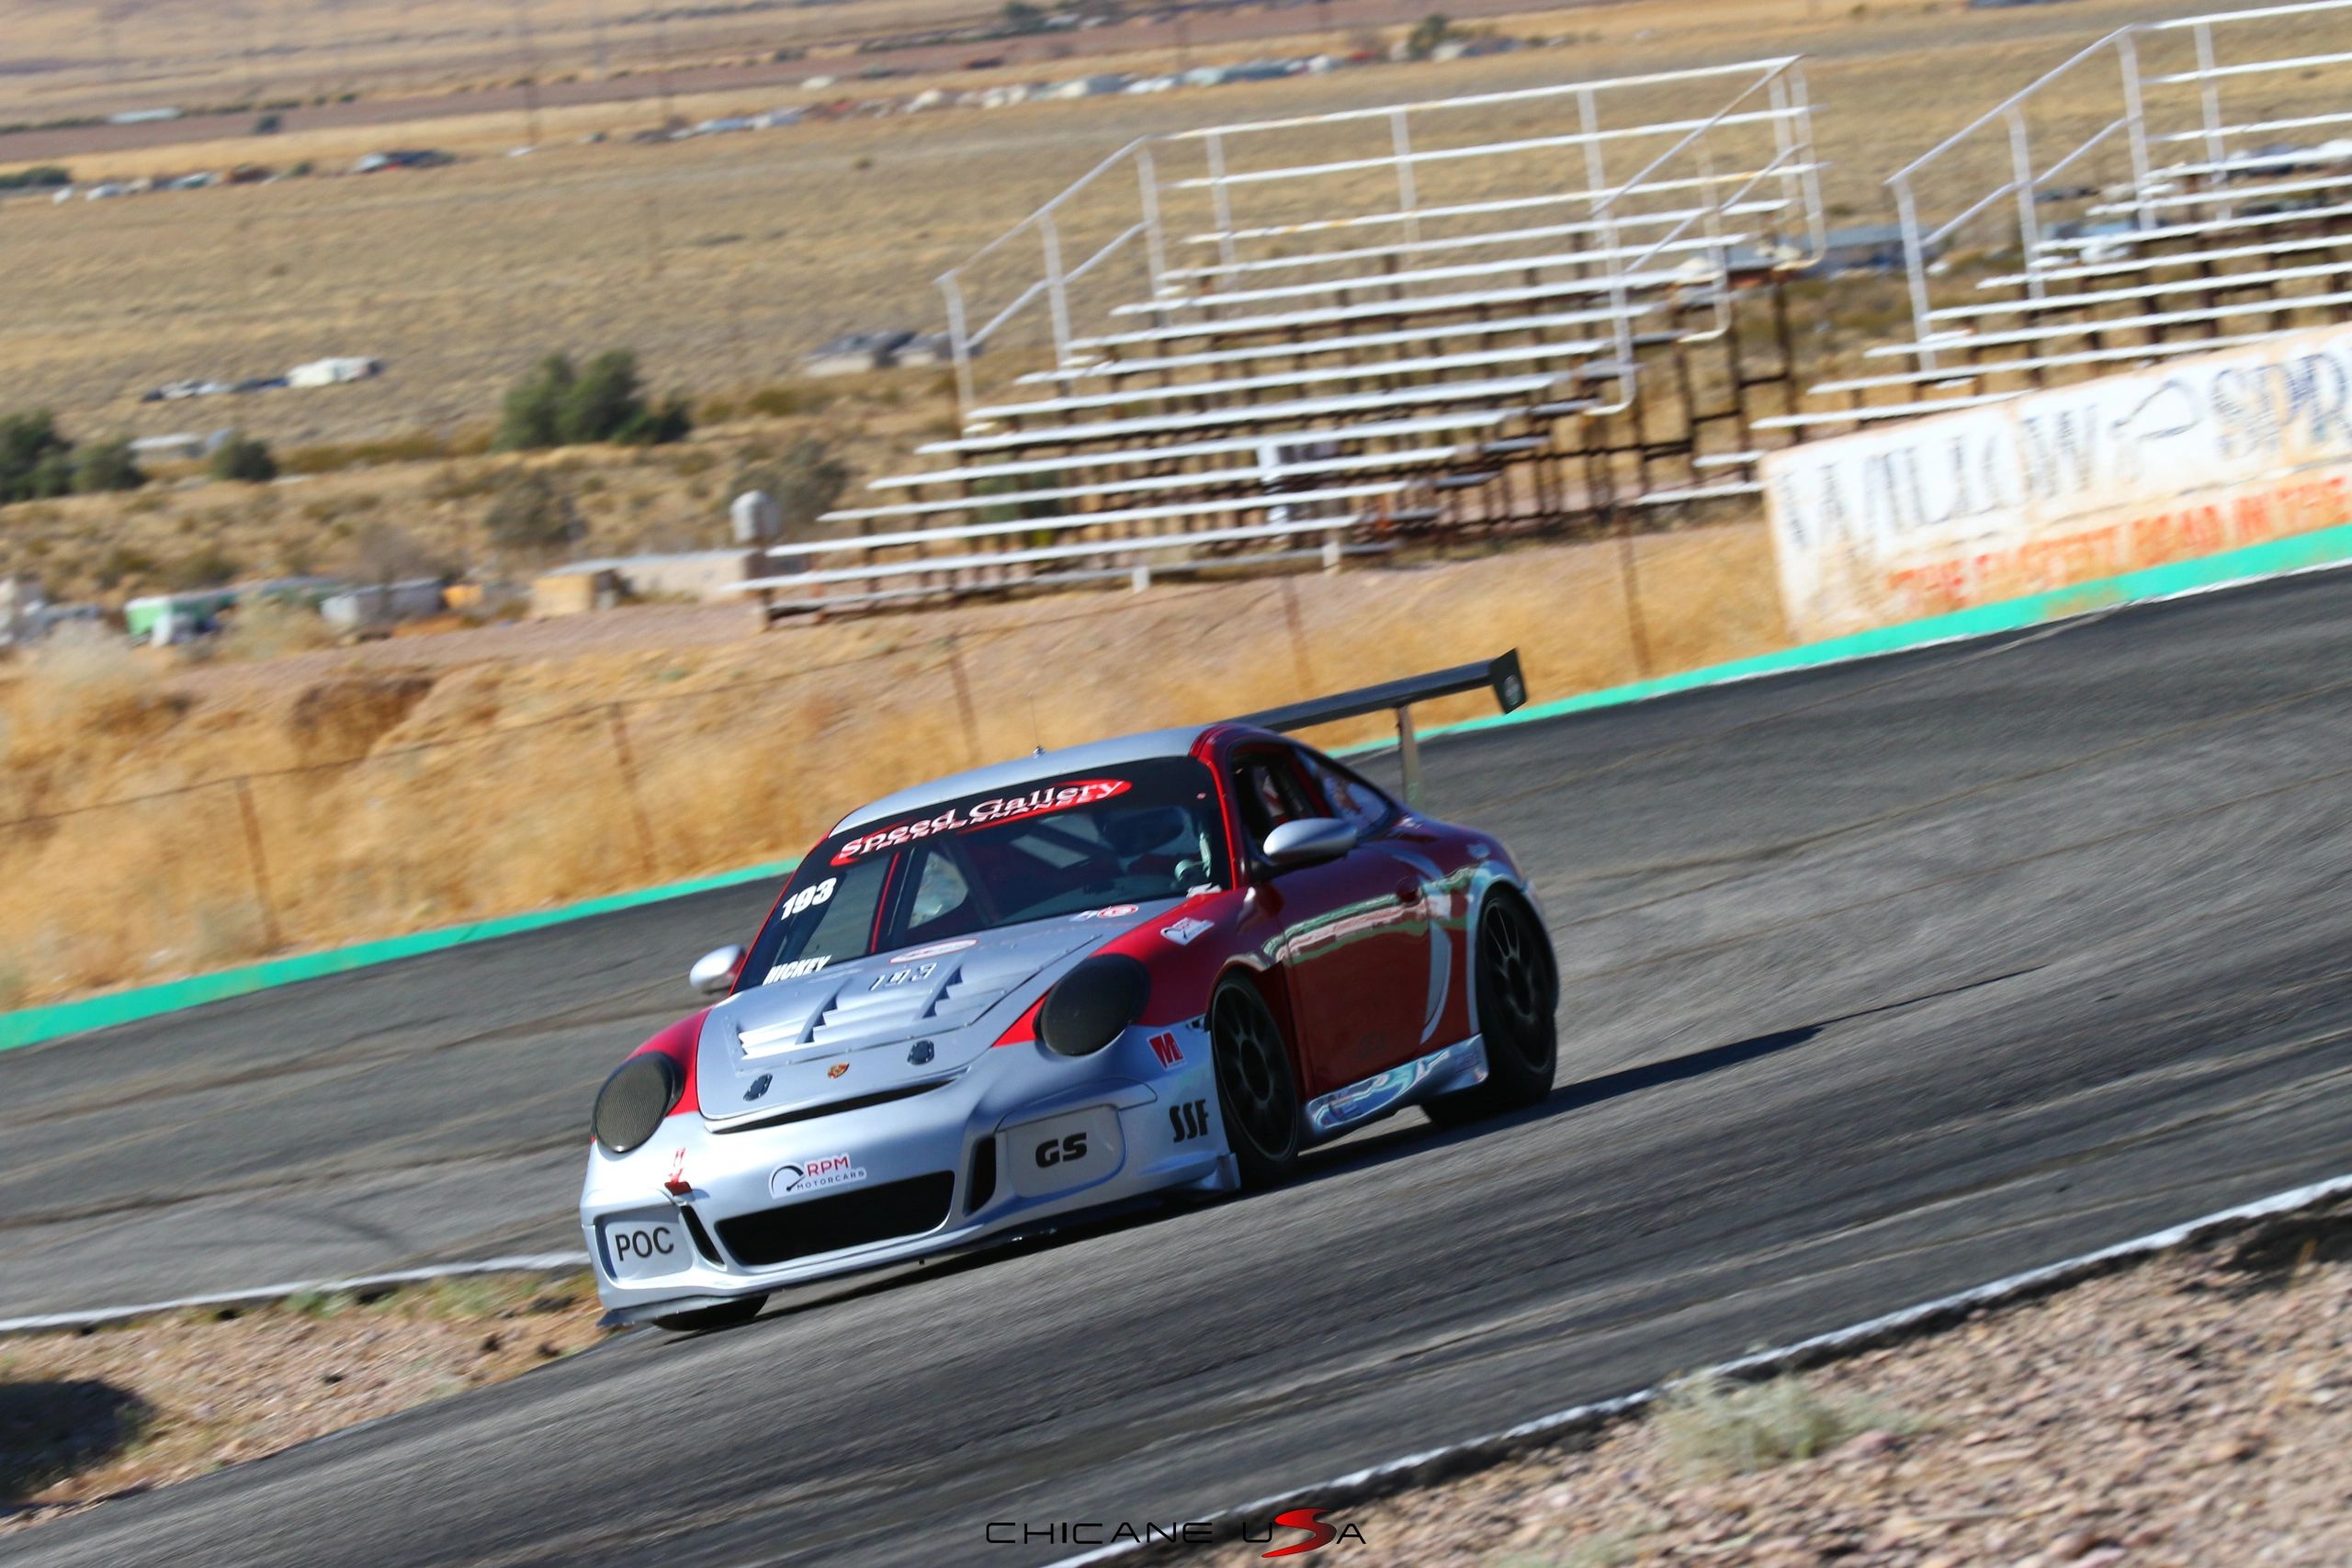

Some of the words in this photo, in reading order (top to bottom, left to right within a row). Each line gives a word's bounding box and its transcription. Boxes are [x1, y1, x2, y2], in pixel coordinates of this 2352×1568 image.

[837, 808, 956, 860] Speed
[968, 780, 1126, 818] Gallery
[780, 876, 837, 921] 193
[1169, 1099, 1209, 1144] SSF
[806, 1156, 849, 1178] RPM
[1035, 1132, 1088, 1169] GS
[796, 1169, 865, 1191] MOTORCARS
[614, 1226, 674, 1262] POC
